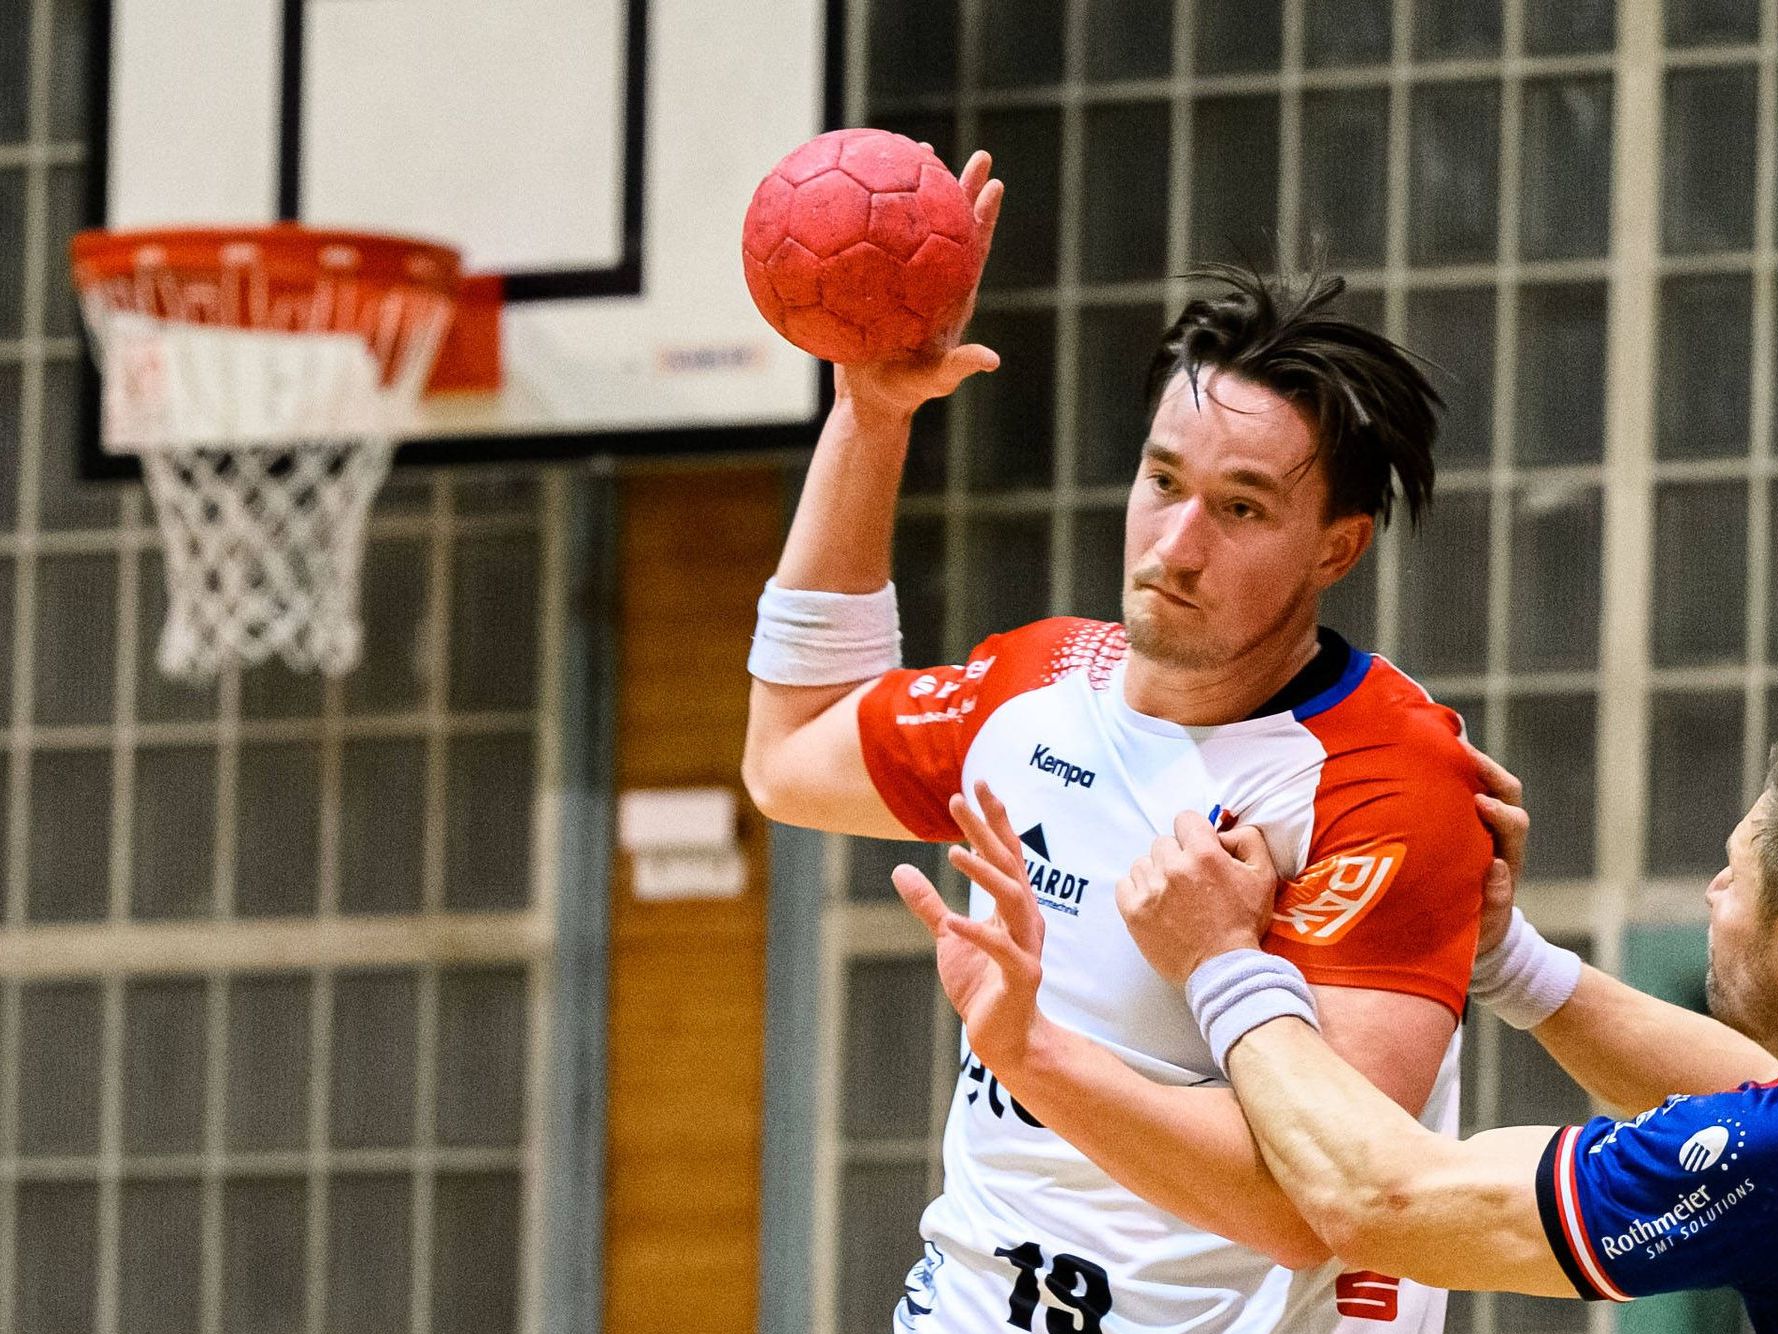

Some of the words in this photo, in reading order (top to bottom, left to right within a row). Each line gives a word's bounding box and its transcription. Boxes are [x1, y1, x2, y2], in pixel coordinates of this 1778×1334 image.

[1029, 744, 1096, 788] Kempa
[1601, 1184, 1711, 1260] Rothmeier
[1646, 1235, 1675, 1260] SMT
[1679, 1177, 1755, 1240] SOLUTIONS
